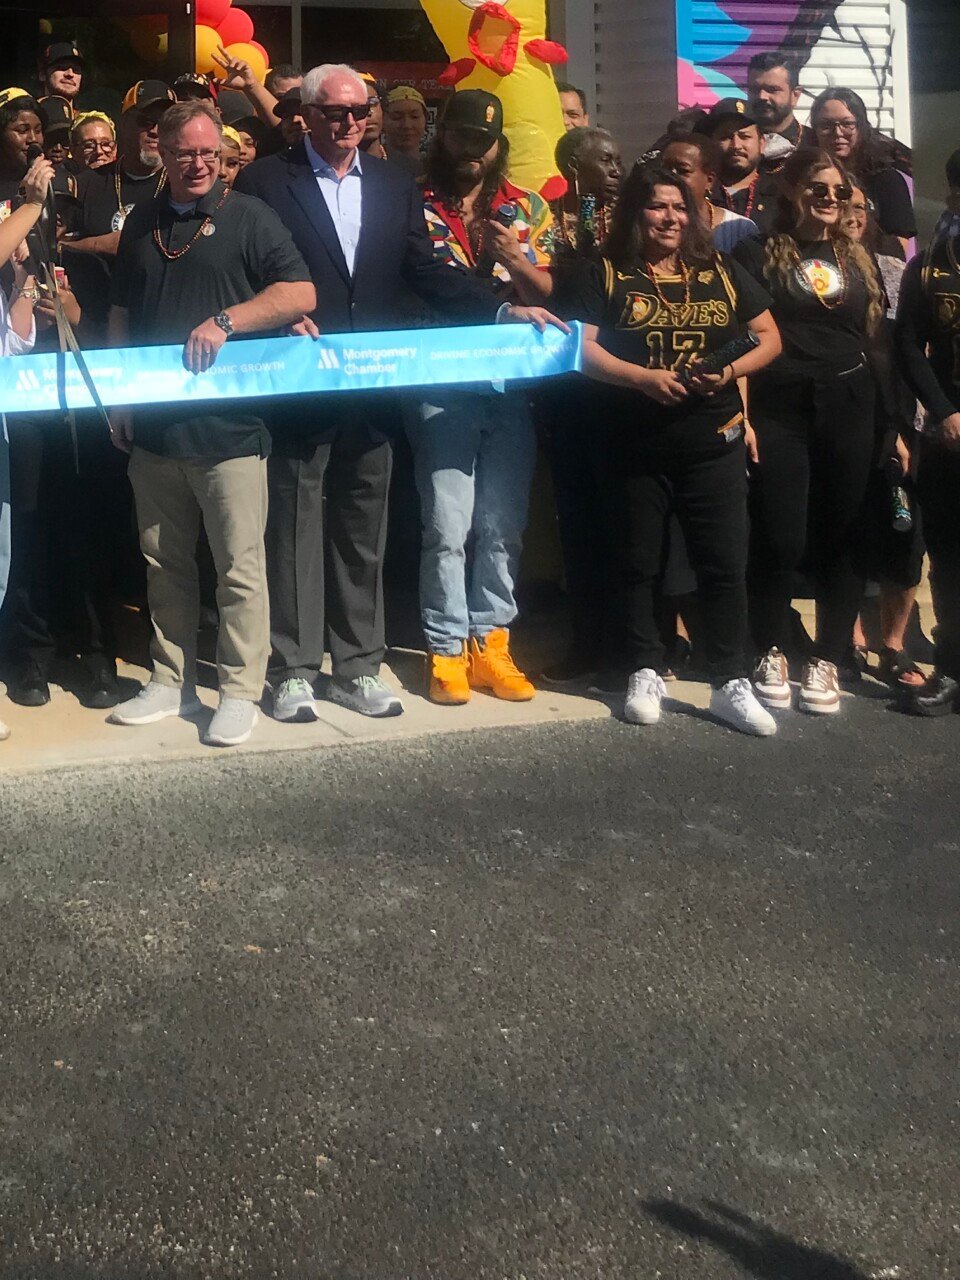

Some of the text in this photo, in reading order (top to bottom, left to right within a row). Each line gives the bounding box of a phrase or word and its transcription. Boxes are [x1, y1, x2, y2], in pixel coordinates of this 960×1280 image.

[615, 291, 729, 330] DAVE'S
[343, 347, 418, 361] Montgomery
[473, 346, 527, 357] ECONOMIC
[646, 331, 705, 371] 17
[240, 361, 286, 375] GROWTH
[344, 362, 397, 375] Chamber
